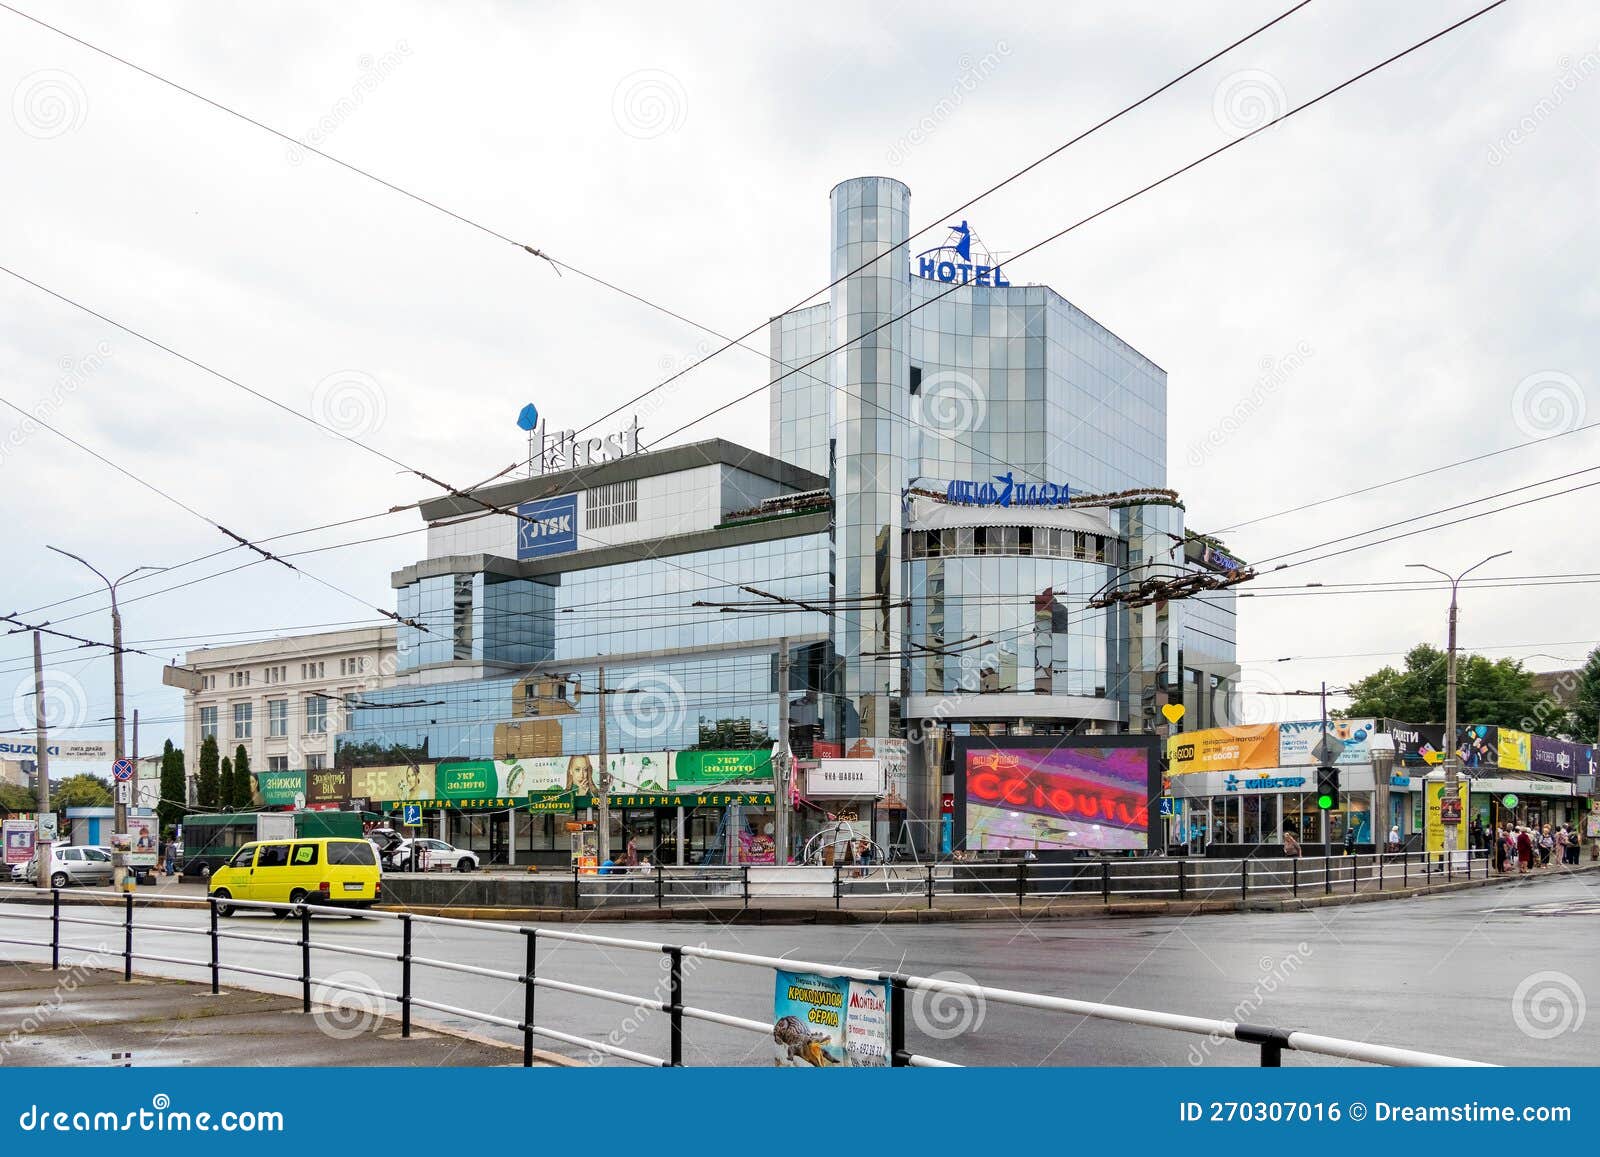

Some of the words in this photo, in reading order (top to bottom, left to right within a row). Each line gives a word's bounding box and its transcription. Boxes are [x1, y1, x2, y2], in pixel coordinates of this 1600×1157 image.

[919, 257, 1010, 288] HOTEL
[530, 515, 571, 538] JYSK
[716, 756, 740, 765] УКР
[704, 764, 753, 774] ЗОЛОТО
[266, 777, 301, 789] ЗНИЖКИ
[447, 781, 485, 789] ЗОЛОТО
[1245, 775, 1306, 790] КИЇВСТАР
[460, 798, 515, 808] МЕРЕЖА
[697, 795, 772, 805] МЕРЕЖА
[531, 802, 571, 810] ЗОЛОТО
[808, 1008, 839, 1027] ФЕРМА
